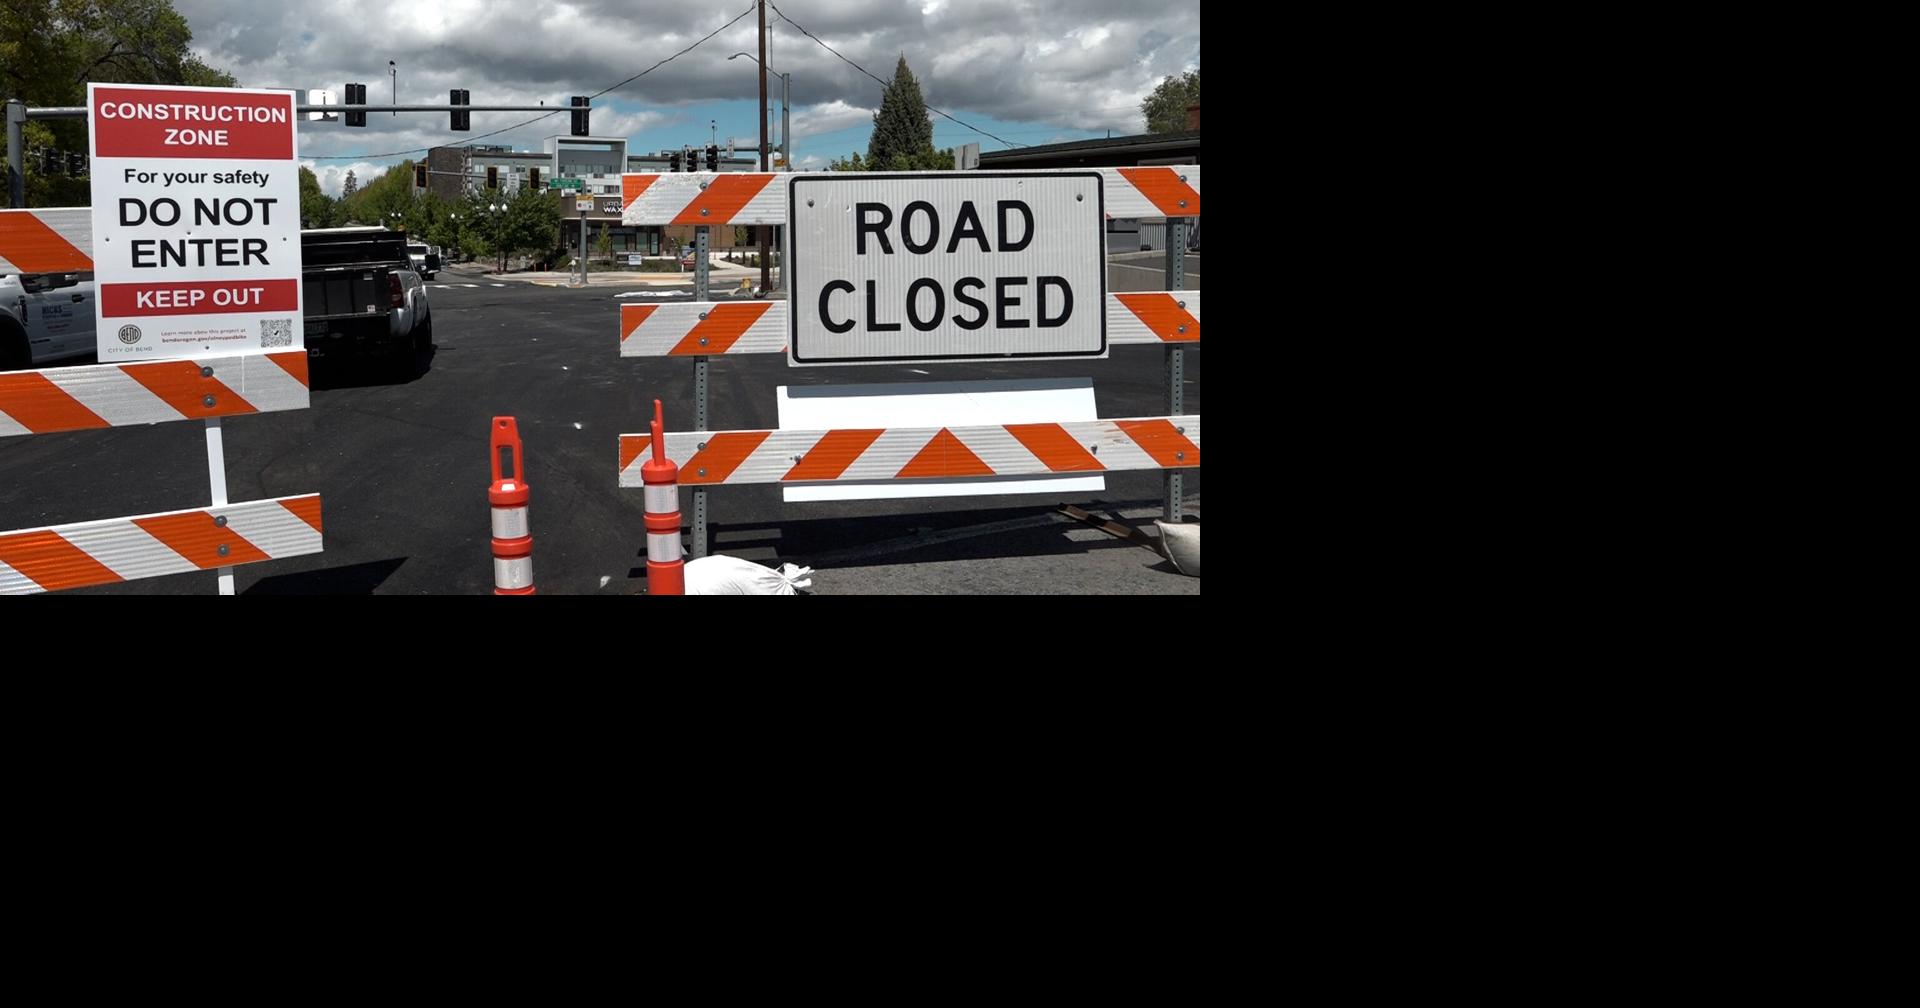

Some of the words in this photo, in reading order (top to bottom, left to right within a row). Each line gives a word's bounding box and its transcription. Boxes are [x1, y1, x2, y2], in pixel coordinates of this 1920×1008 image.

[100, 102, 286, 123] CONSTRUCTION
[164, 129, 229, 146] ZONE
[124, 169, 158, 184] For
[163, 171, 208, 187] your
[213, 169, 270, 188] safety
[119, 198, 181, 227] DO
[194, 198, 278, 226] NOT
[855, 200, 1035, 255] ROAD
[131, 238, 270, 268] ENTER
[136, 290, 205, 309] KEEP
[212, 287, 264, 306] OUT
[818, 275, 1074, 334] CLOSED
